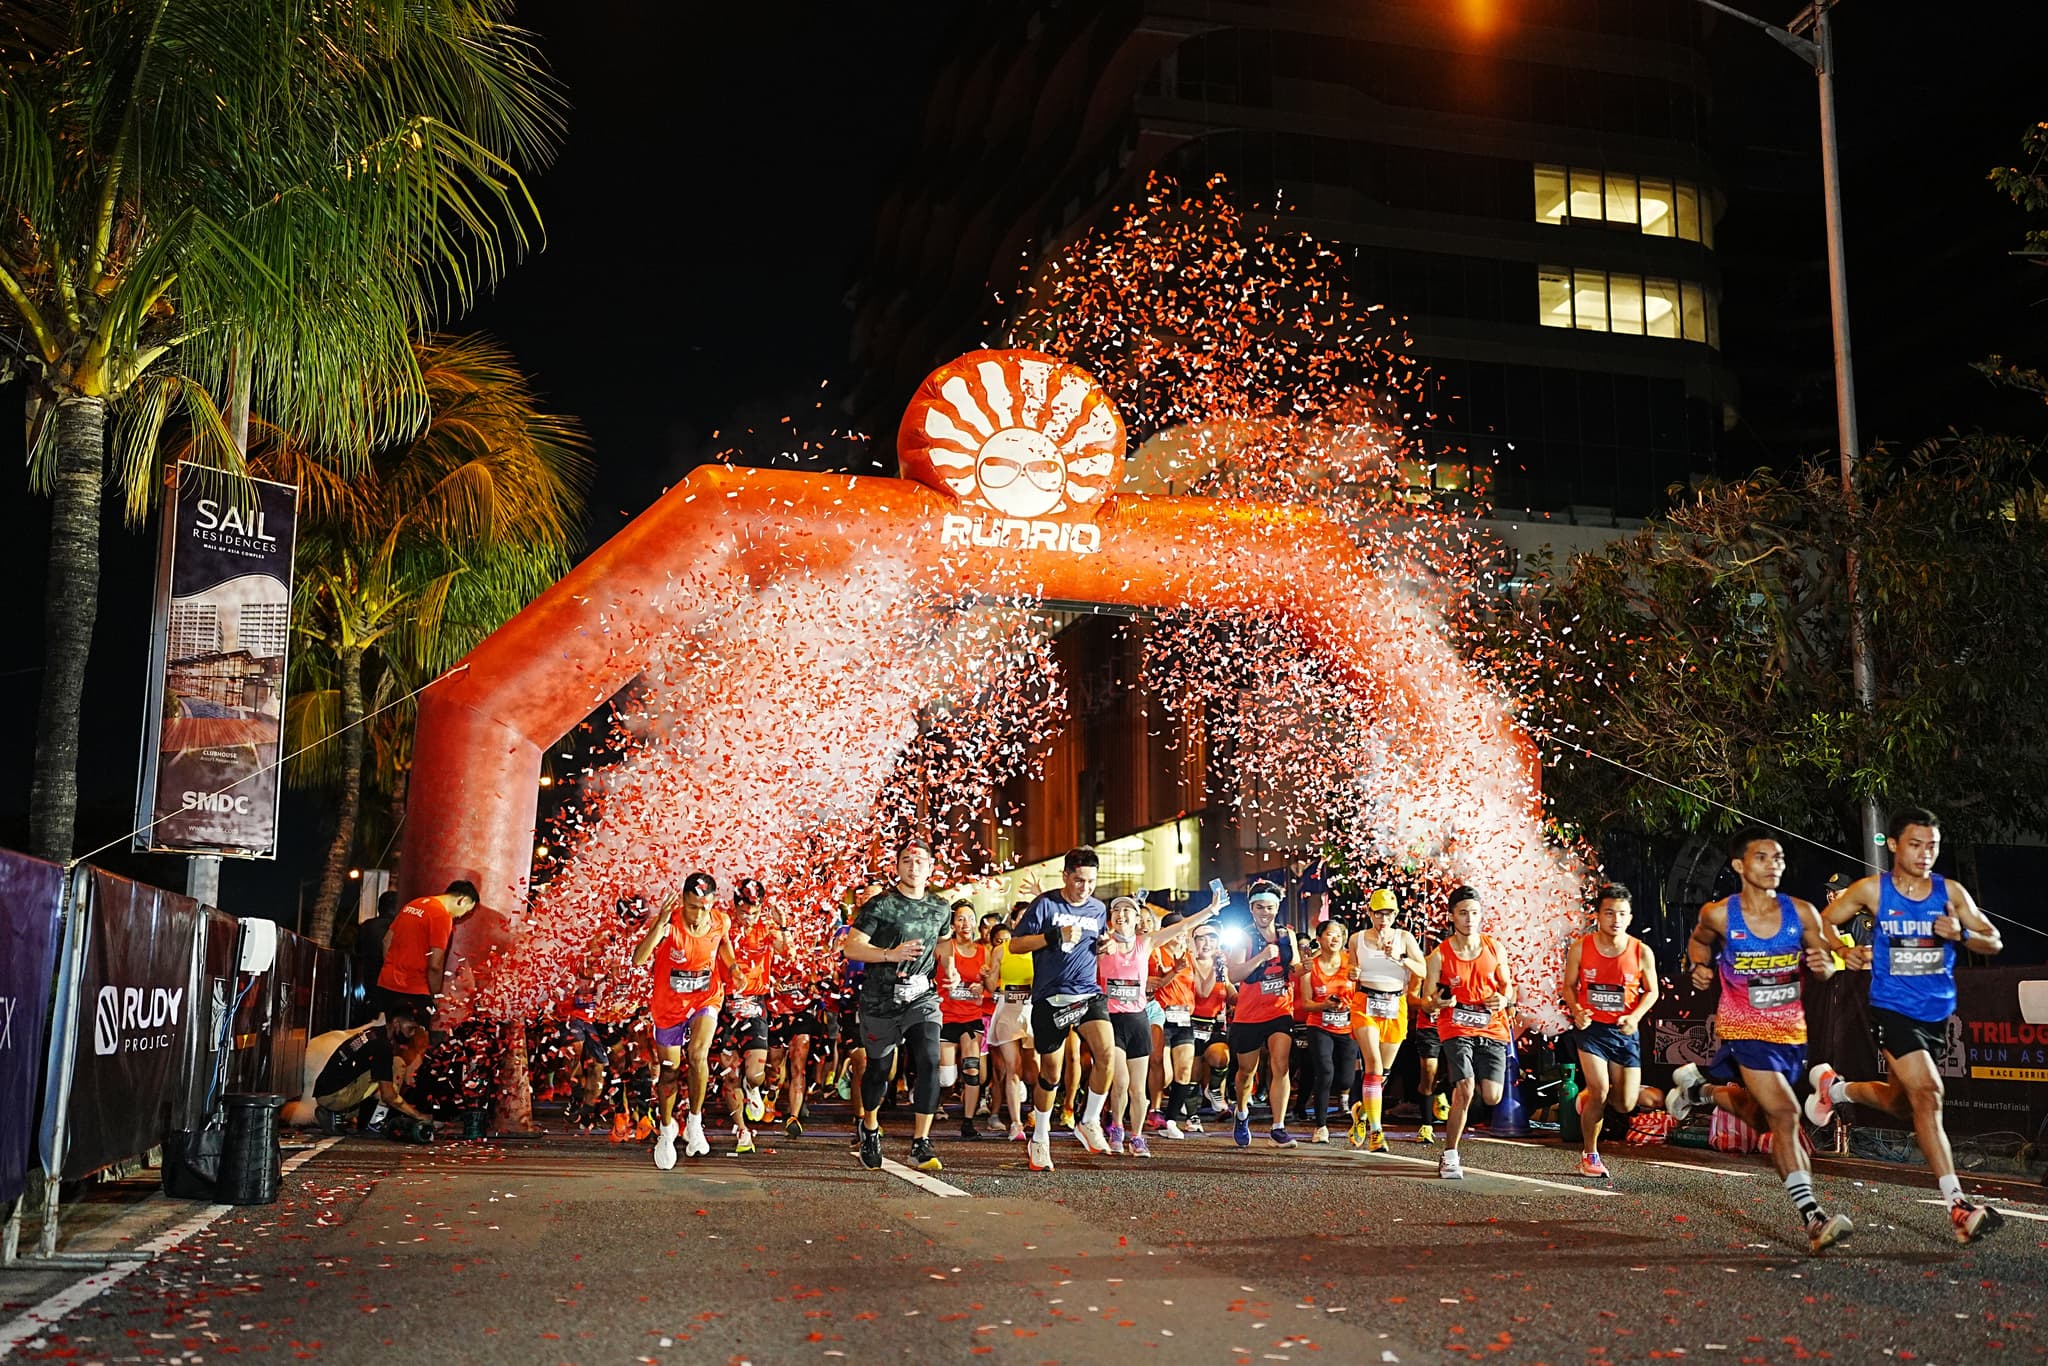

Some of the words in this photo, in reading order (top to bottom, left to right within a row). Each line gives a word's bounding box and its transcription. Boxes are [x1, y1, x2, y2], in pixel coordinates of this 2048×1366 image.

[195, 499, 276, 542] SAIL
[193, 528, 277, 553] RESIDENCES
[202, 750, 238, 759] CLUBHOUSE
[182, 790, 249, 815] SMDC
[1894, 951, 1941, 963] 29407
[1591, 992, 1621, 1003] 28162
[1754, 986, 1796, 1003] 27479
[122, 987, 183, 1030] RUDY
[1456, 1011, 1488, 1024] 27752
[1970, 1047, 2007, 1062] RUN
[1990, 1069, 2013, 1078] RACE
